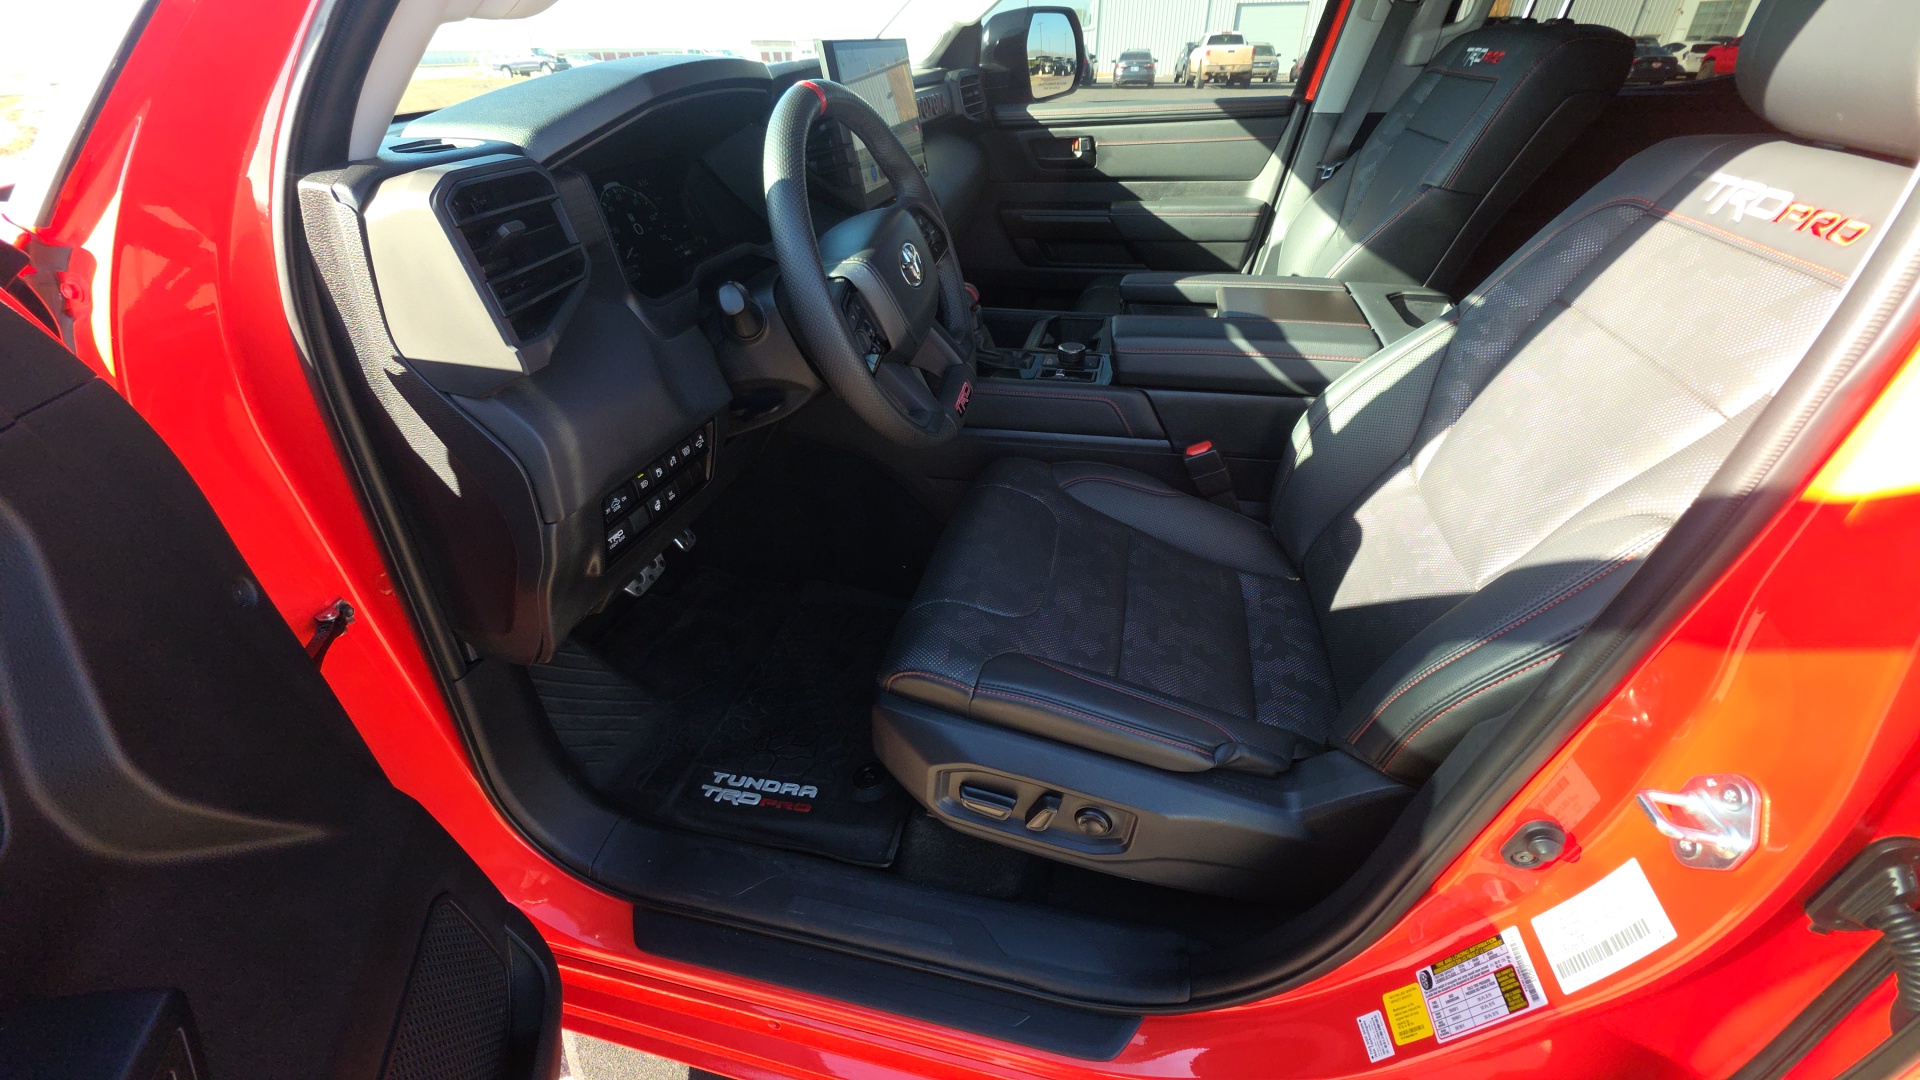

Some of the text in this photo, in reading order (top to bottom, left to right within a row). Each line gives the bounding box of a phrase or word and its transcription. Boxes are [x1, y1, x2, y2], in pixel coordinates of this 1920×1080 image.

[1463, 47, 1489, 66] TRD
[1704, 172, 1871, 247] TRD PRO
[955, 381, 971, 414] TRD
[608, 529, 624, 543] TRD
[701, 784, 812, 813] TRD PRO
[713, 771, 818, 798] TUNDRA
